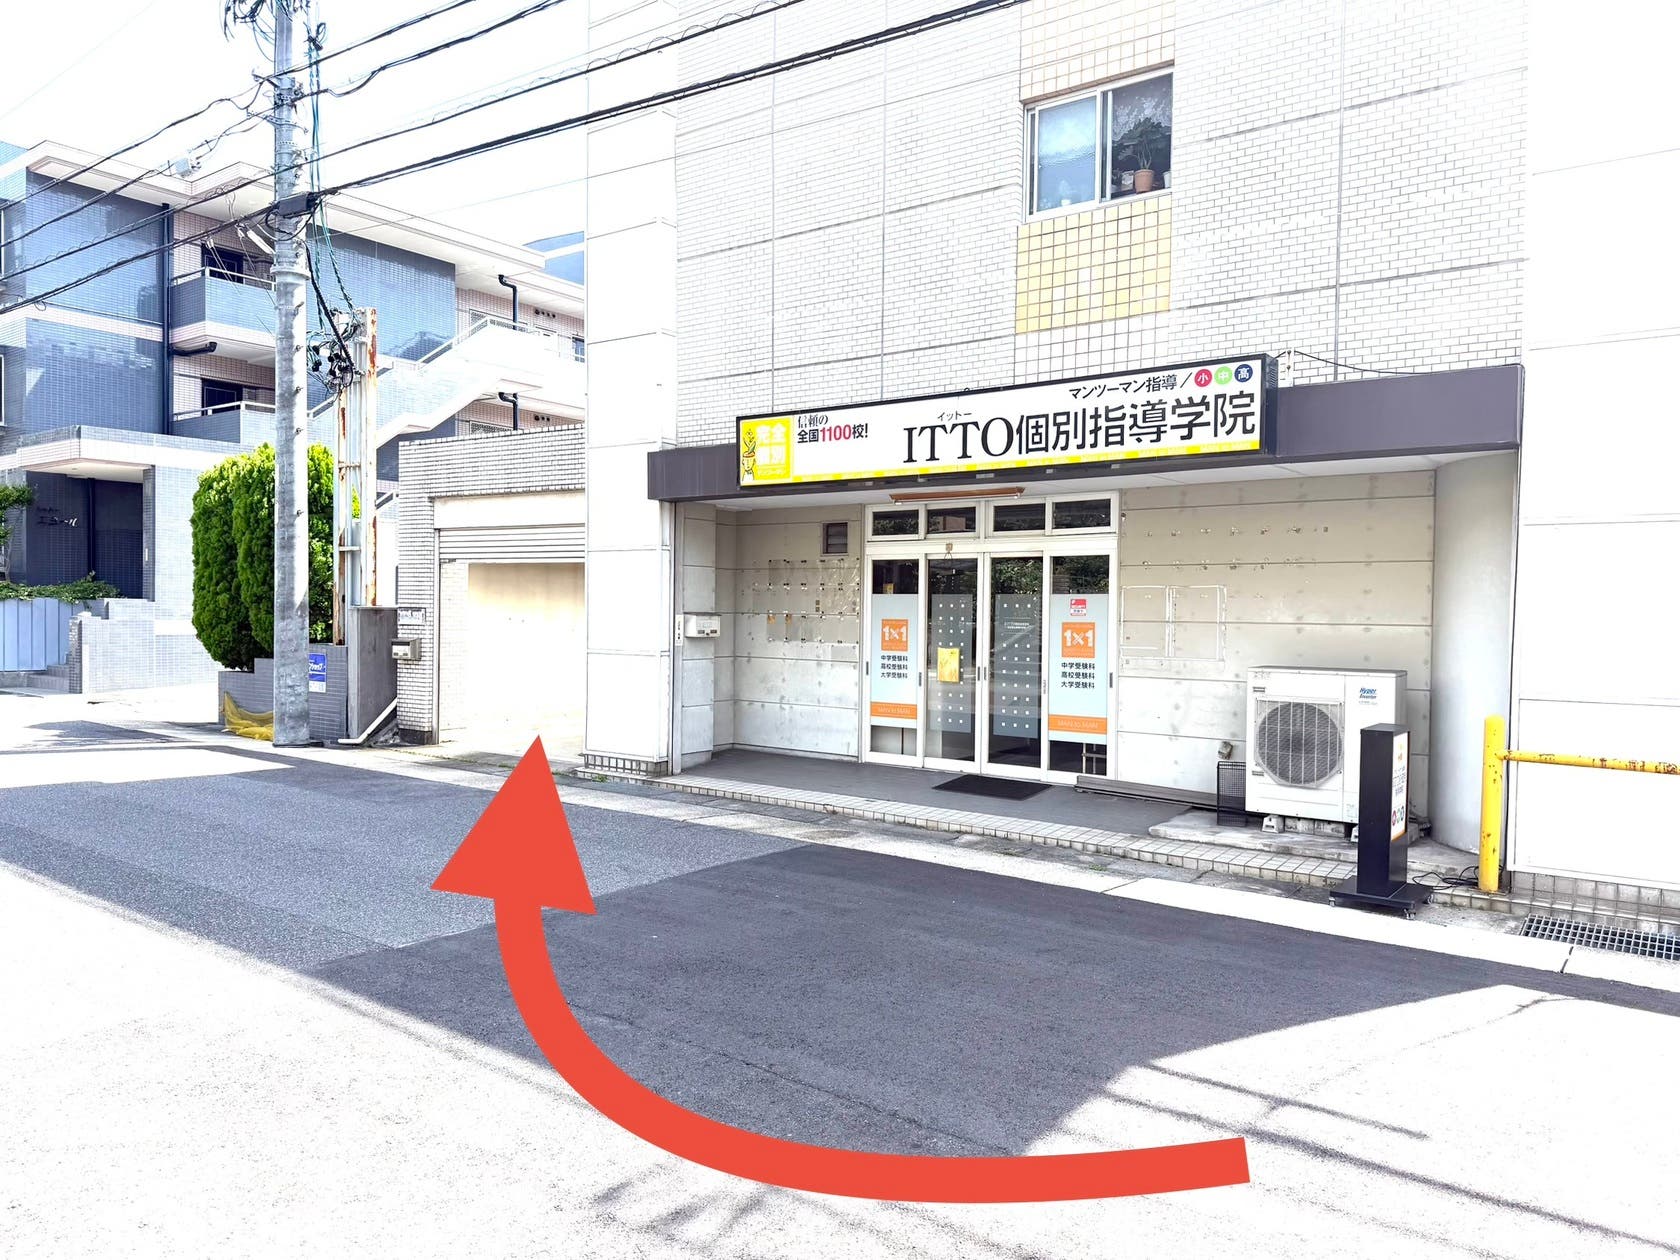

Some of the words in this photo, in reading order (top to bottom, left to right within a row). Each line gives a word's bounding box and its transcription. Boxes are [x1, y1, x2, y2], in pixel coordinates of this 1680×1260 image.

[937, 410, 972, 421] イットー
[797, 414, 829, 428] 信頼の
[903, 390, 1256, 464] ITTO個別指導学院
[1061, 662, 1096, 670] 中学受験科
[1061, 671, 1095, 680] 高校受験科
[1061, 681, 1095, 689] 大学受験科
